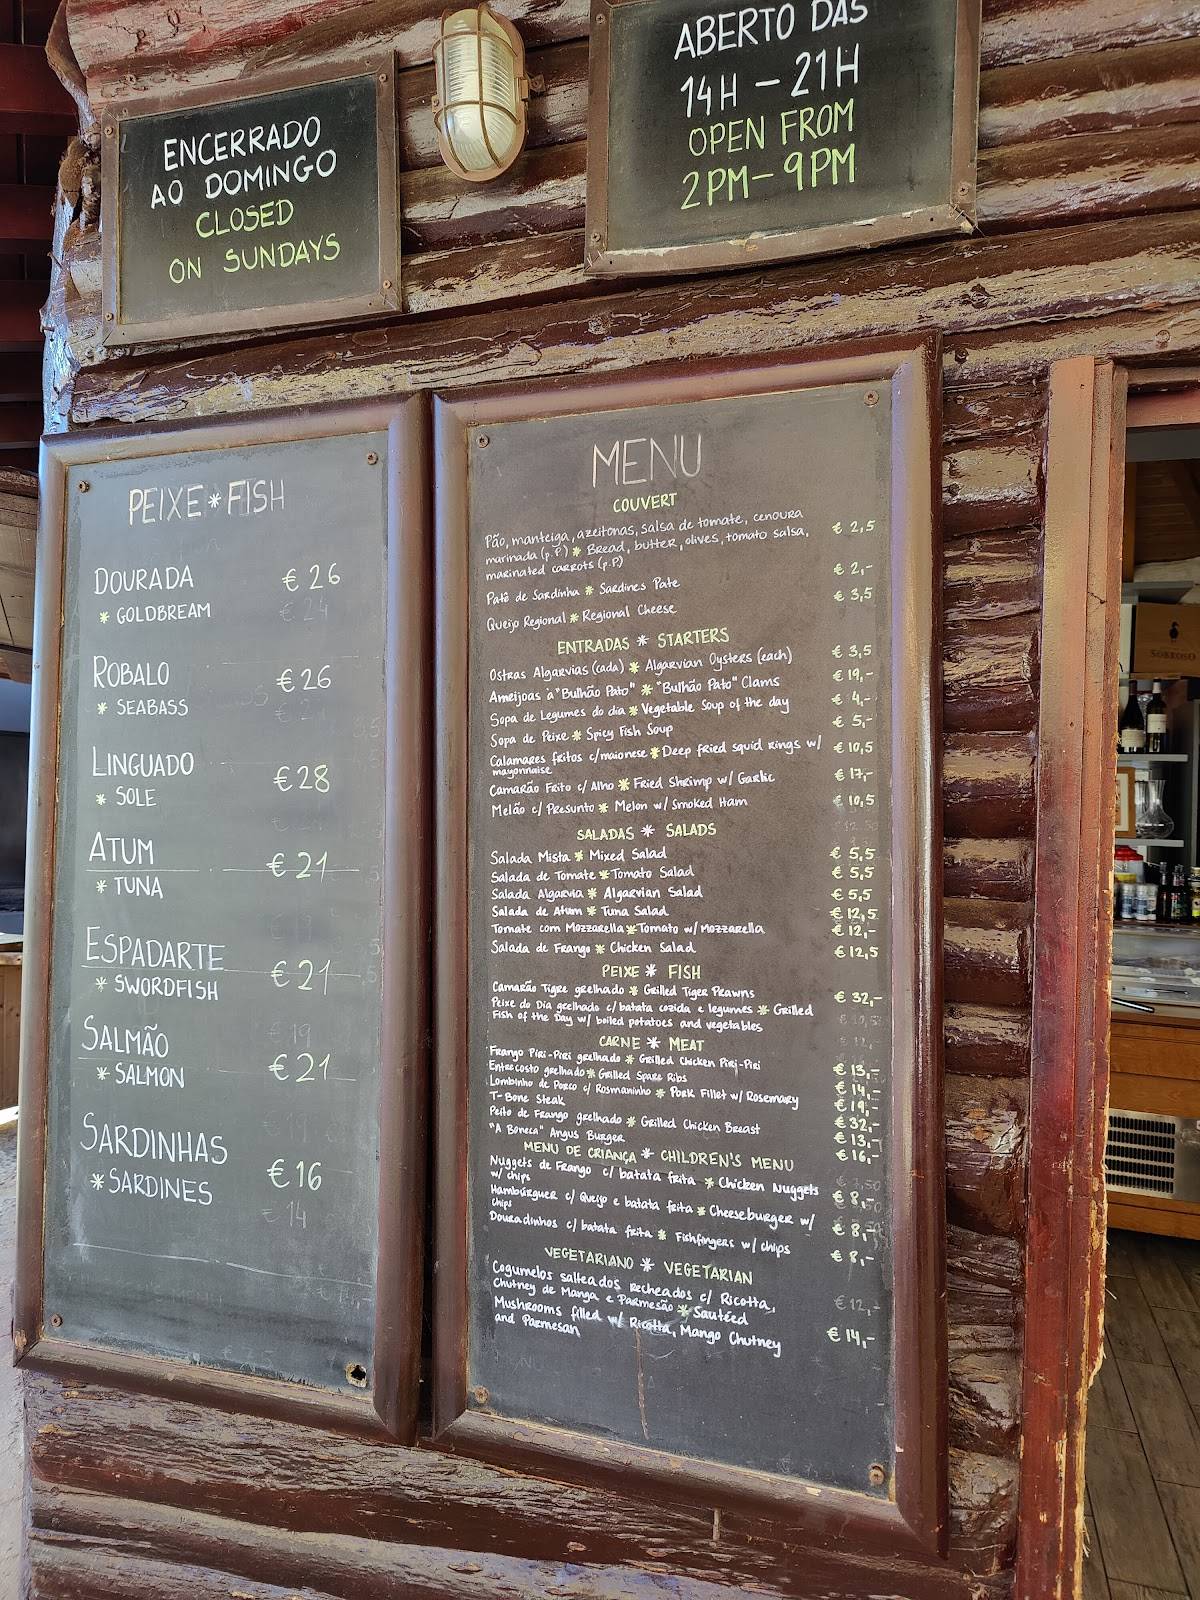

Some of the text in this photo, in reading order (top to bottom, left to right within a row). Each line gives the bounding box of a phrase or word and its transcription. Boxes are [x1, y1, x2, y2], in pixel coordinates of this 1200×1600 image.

[673, 0, 869, 61] ABERTO DAS
[688, 97, 854, 157] OPEN FROM
[163, 116, 322, 173] ENCERRADO
[150, 148, 338, 210] AO DOMINGO
[195, 199, 294, 239] CLOSED
[168, 232, 341, 284] ON SUNDAYS
[592, 433, 702, 489] MENU
[612, 492, 678, 513] COUVERT
[640, 519, 675, 535] salsa
[725, 529, 768, 542] tomato
[94, 564, 194, 595] DOURADA
[652, 576, 681, 590] Pate
[116, 602, 211, 625] GOLDBREAM
[486, 603, 678, 634] Queijo Regional Regional Cheese
[557, 626, 730, 655] ENTRADAS STARTERS
[93, 655, 170, 689] ROBALO
[488, 690, 542, 708] Ameijoas
[741, 675, 780, 689] Clams
[116, 698, 189, 717] SEABASS
[489, 695, 790, 728] Sopa Legumes dia Vegetable Soup day
[490, 722, 674, 749] Sopa Peixe Spicy Fish Soup
[731, 737, 764, 755] squid
[92, 745, 195, 778] LINGUADO
[492, 766, 553, 780] mayonnaise
[115, 785, 157, 807] SOLE
[590, 780, 615, 792] Alho
[491, 796, 714, 818] Melão Melon Smoked
[576, 822, 717, 841] SALADAS SALADS
[88, 831, 154, 865] ATUM
[489, 845, 668, 865] Salada Mista Mixed Salad
[490, 864, 695, 884] Salada Tomate Tomato Salad
[113, 875, 164, 899] TUNA
[491, 887, 532, 900] Salada
[491, 904, 670, 918] Salada Atum Tuna Salad
[490, 922, 679, 935] Tomate Tomato
[86, 926, 226, 971] ESPADARTE
[490, 939, 697, 954] Salada Chicken Salad
[601, 963, 701, 980] PEIXE FISH
[114, 973, 219, 1001] SWORDFISH
[490, 995, 754, 1018] Peixe Dia cozida legumes
[492, 1009, 514, 1020] Fish
[553, 1011, 574, 1027] Day
[595, 1015, 625, 1026] boiled
[80, 1014, 169, 1058] SALMÃO
[598, 1035, 705, 1052] CARNE MEAT
[679, 1056, 716, 1068] Chicken
[115, 1061, 185, 1089] SALMON
[489, 1104, 512, 1117] Peito
[535, 1093, 566, 1107] Steak
[79, 1111, 228, 1165] SARDINHAS
[523, 1140, 794, 1172] MENU DE CRIANÇA CHILDREN'S MENU
[108, 1167, 213, 1206] SARDINES
[618, 1166, 662, 1182] batata
[718, 1176, 766, 1192] Chicken
[579, 1191, 661, 1211] Queijo batata
[581, 1218, 618, 1235] batata
[544, 1246, 753, 1286] VEGETARIANO VEGETARIAN
[492, 1277, 537, 1297] Chutney
[679, 1323, 782, 1359] Mango Chutney
